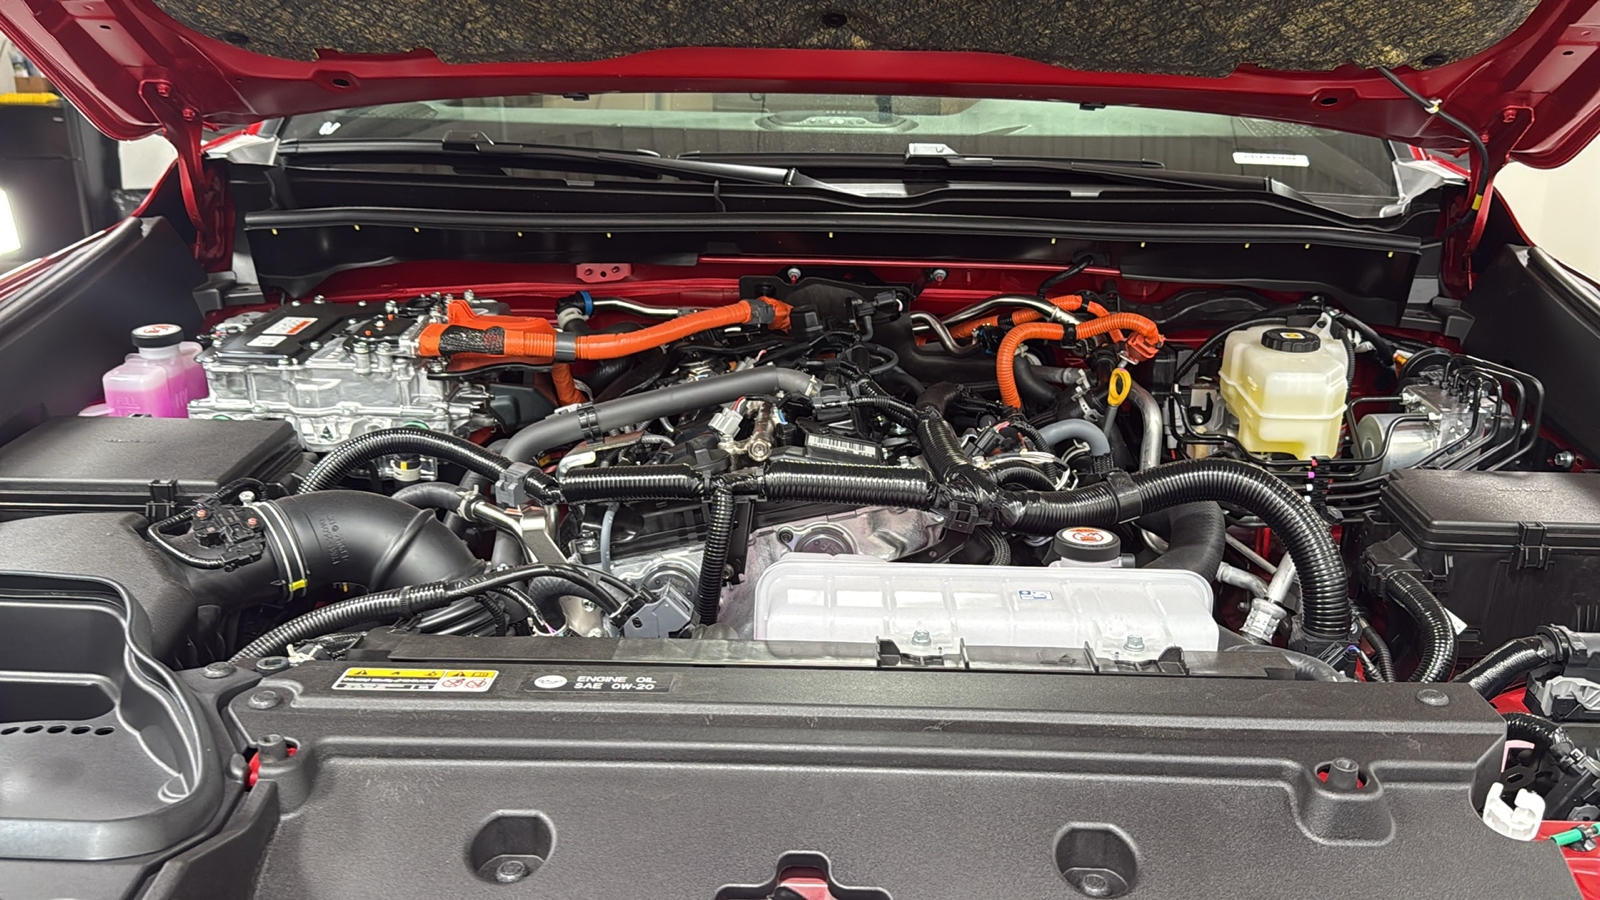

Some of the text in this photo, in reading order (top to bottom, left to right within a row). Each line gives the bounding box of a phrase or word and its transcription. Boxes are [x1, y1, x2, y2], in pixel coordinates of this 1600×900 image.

[576, 675, 657, 684] ENGINE OIL
[573, 682, 603, 690] SAE
